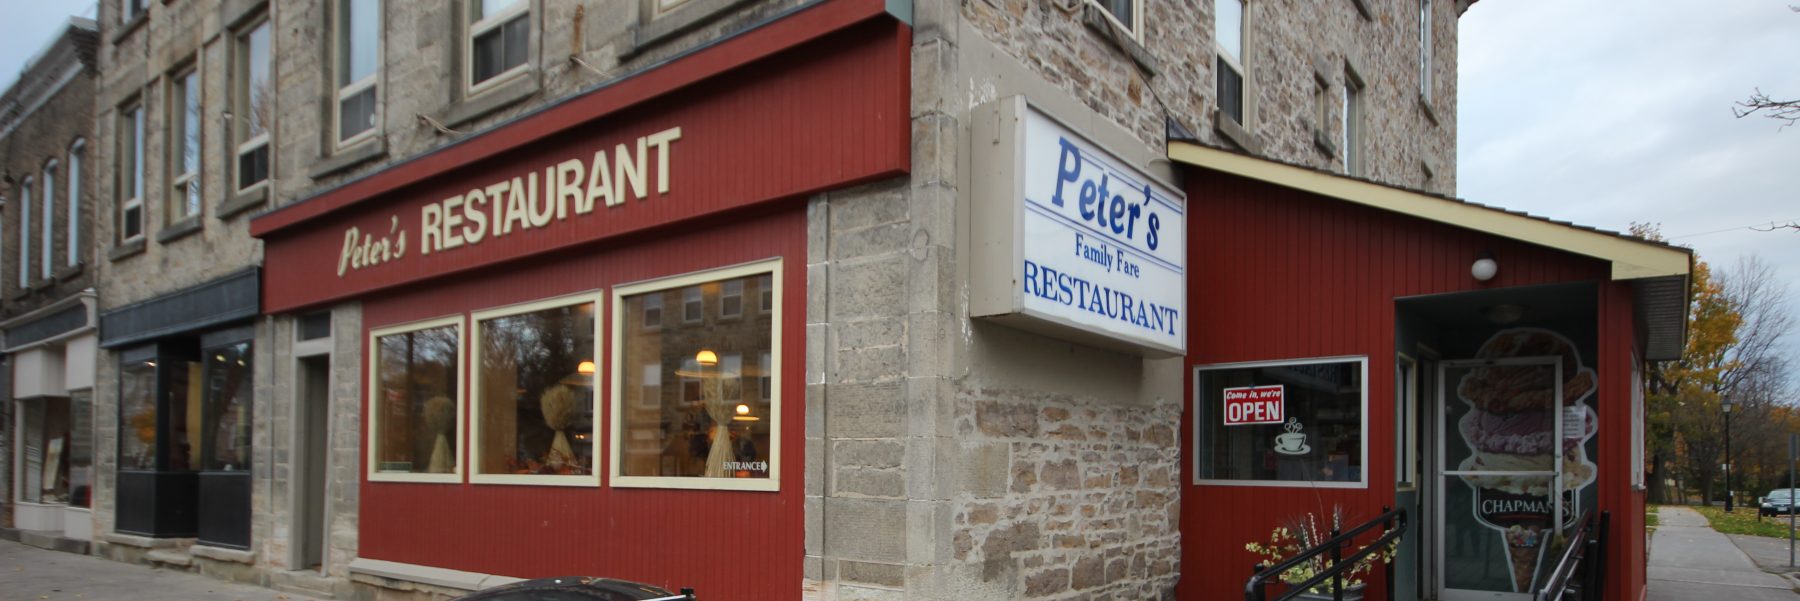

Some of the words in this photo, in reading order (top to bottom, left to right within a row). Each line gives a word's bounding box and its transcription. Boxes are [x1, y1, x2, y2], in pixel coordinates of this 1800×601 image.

[337, 215, 407, 278] Peter's
[421, 126, 682, 255] RESTAURANT
[1052, 136, 1160, 251] Peter's
[1075, 232, 1113, 273] Family
[1116, 249, 1140, 279] Fare
[1024, 259, 1178, 336] RESTAURANT
[1226, 391, 1247, 399] Come
[1249, 390, 1259, 399] in,
[1260, 389, 1281, 398] we're
[1228, 401, 1280, 422] OPEN
[723, 461, 761, 471] ENTRANCE
